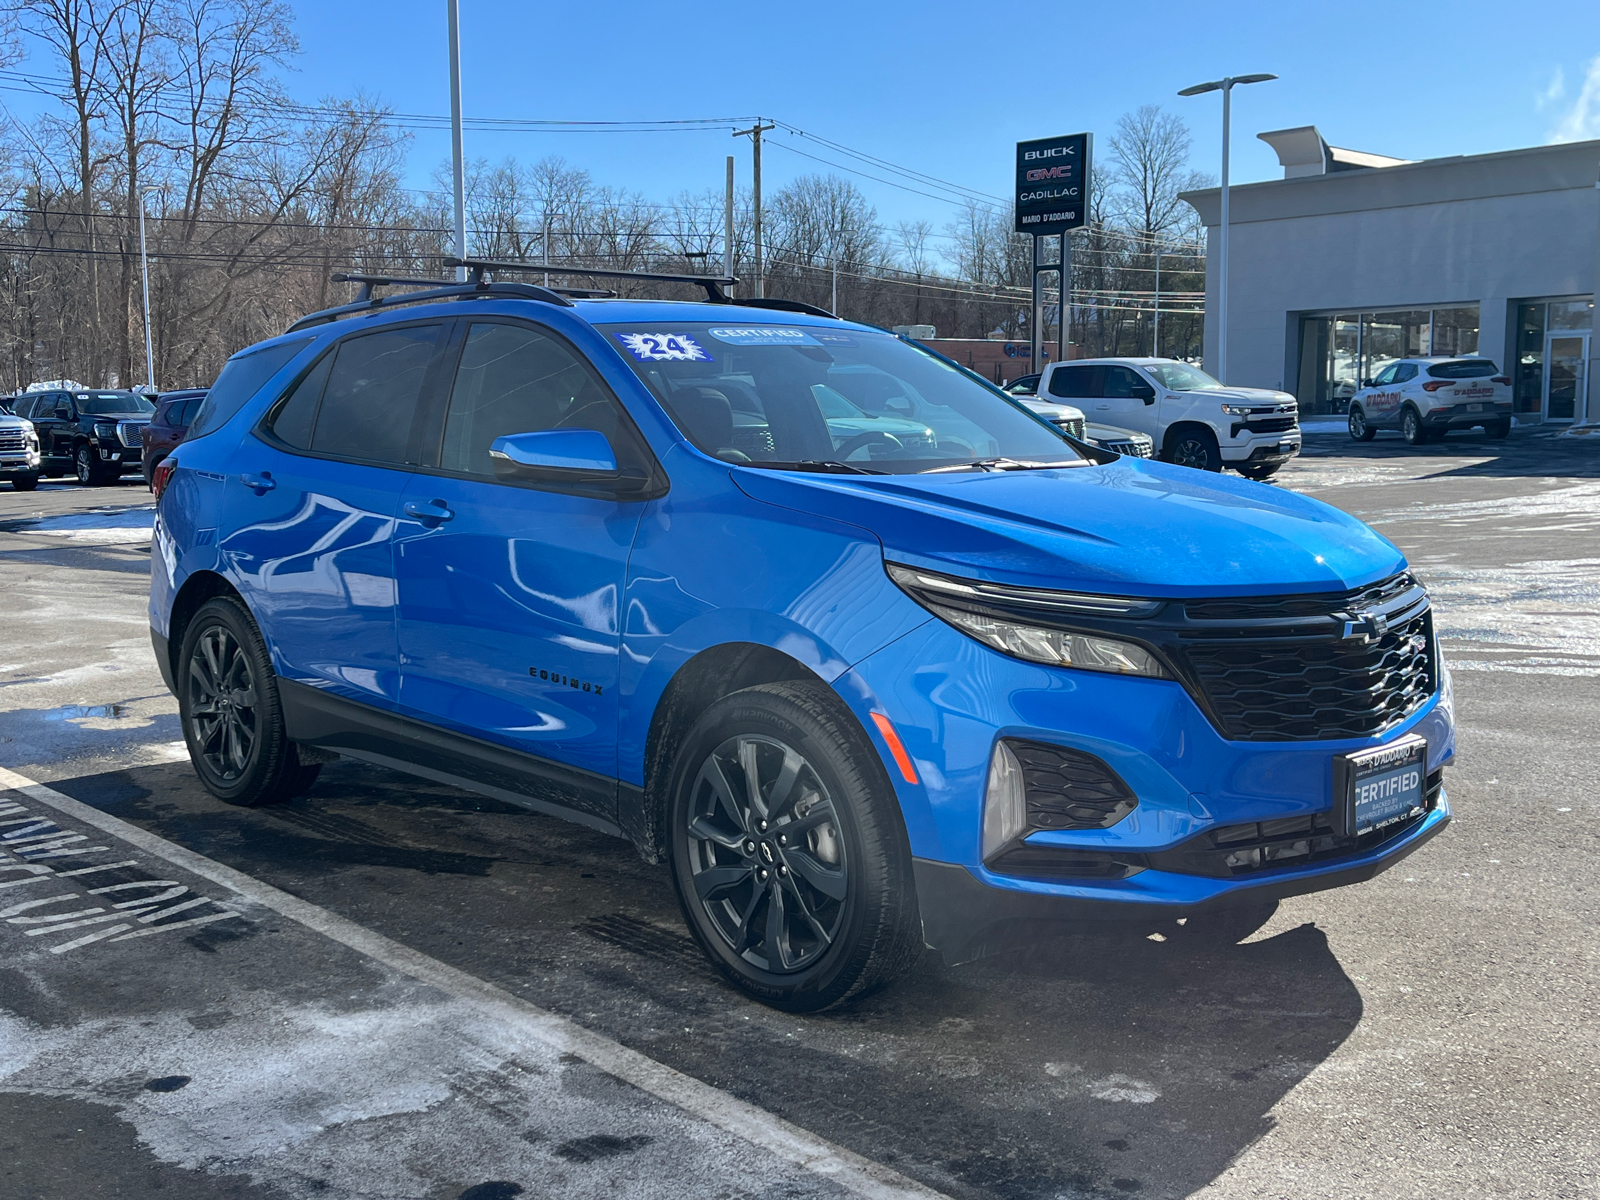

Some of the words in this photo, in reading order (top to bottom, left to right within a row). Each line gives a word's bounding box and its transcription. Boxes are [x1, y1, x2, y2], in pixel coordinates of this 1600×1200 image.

[1024, 145, 1075, 160] BUICK
[1026, 165, 1072, 182] GMC
[1020, 187, 1078, 201] CADILLAC
[1022, 214, 1041, 224] MARIO
[1043, 211, 1076, 222] D'ADDARIO
[712, 329, 804, 338] CERTIFIED
[640, 337, 686, 355] 24
[1453, 387, 1494, 396] D'ADDARIO
[529, 666, 603, 696] EQUINOX
[1374, 746, 1411, 766] D'ADDARIO
[1355, 771, 1419, 807] CERTIFIED
[1372, 798, 1391, 810] BACKED
[1391, 797, 1399, 805] BY
[1356, 809, 1384, 822] CHEVROLET
[1384, 804, 1399, 814] BUICK
